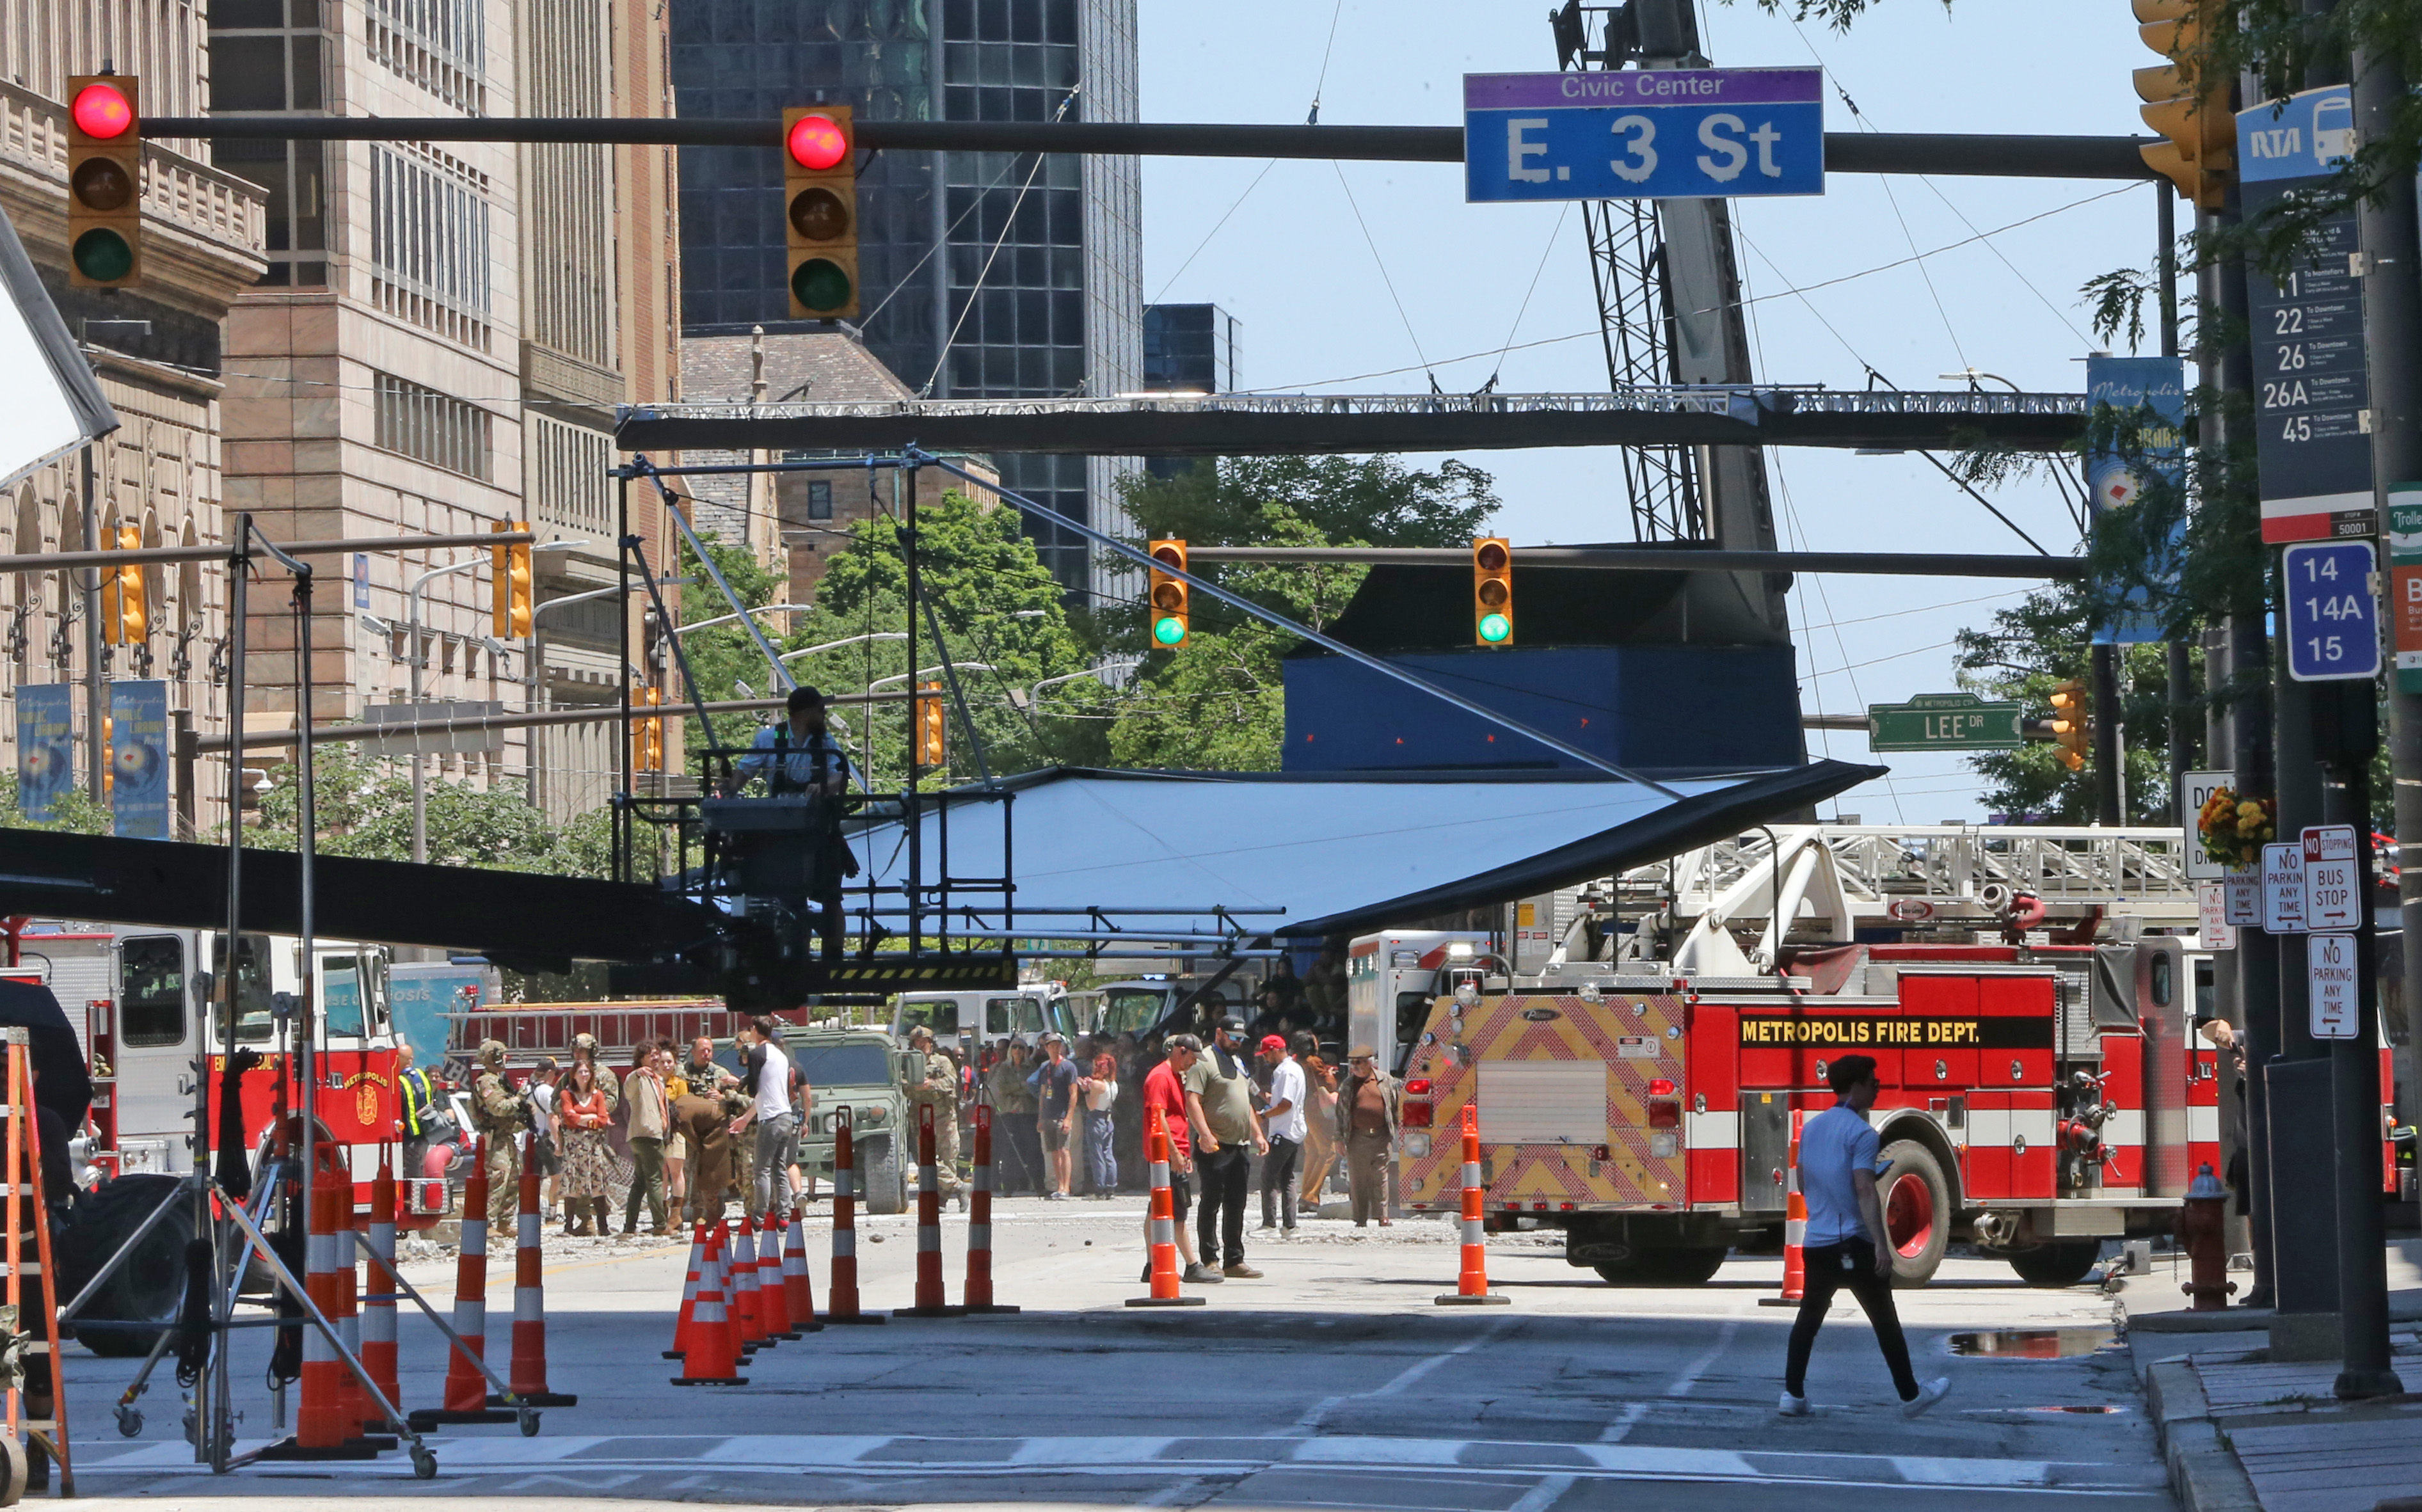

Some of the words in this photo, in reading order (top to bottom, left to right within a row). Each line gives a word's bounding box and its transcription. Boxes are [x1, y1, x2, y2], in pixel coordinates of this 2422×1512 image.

[1561, 75, 1624, 98] Civic
[1636, 74, 1725, 97] Center
[1507, 118, 1570, 184] E.
[1610, 114, 1659, 184] 3
[1696, 112, 1781, 183] St
[2251, 127, 2301, 159] RTA
[2275, 308, 2303, 335] 22
[2317, 341, 2348, 349] Downtown
[2278, 344, 2305, 371] 26
[2320, 377, 2350, 385] Downtown
[2263, 380, 2309, 409] 26A
[2322, 413, 2352, 422] Downtown
[2283, 417, 2311, 442] 45
[2339, 523, 2366, 535] 50001
[2304, 557, 2338, 582] 14
[2306, 594, 2363, 622] 14A
[2307, 635, 2343, 662] 15
[1924, 699, 1961, 707] METROPOLIS
[113, 708, 142, 721] PUBLIC
[130, 720, 164, 734] LIBRARY
[1925, 715, 1966, 739] LEE
[1969, 715, 1984, 728] DR
[2305, 837, 2319, 854] NO
[2322, 838, 2352, 851] STOPPING
[2279, 854, 2298, 870] NO
[2227, 876, 2259, 886] PARKING
[2268, 872, 2303, 884] PARKIN
[2318, 869, 2344, 886] BUS
[2209, 893, 2222, 905] NO
[2236, 888, 2250, 897] ANY
[2279, 887, 2299, 898] ANY
[2316, 889, 2348, 907] STOP
[2235, 900, 2252, 909] TIME
[2278, 901, 2300, 912] TIME
[2323, 946, 2341, 964] NO
[2314, 967, 2352, 982] PARKING
[2323, 985, 2341, 998] ANY
[2323, 1001, 2343, 1014] TIME
[1742, 1021, 1870, 1042] METROPOLIS
[1876, 1022, 1922, 1042] FIRE
[1927, 1022, 1980, 1043] DEPT.
[344, 1071, 388, 1090] METROPOLIS
